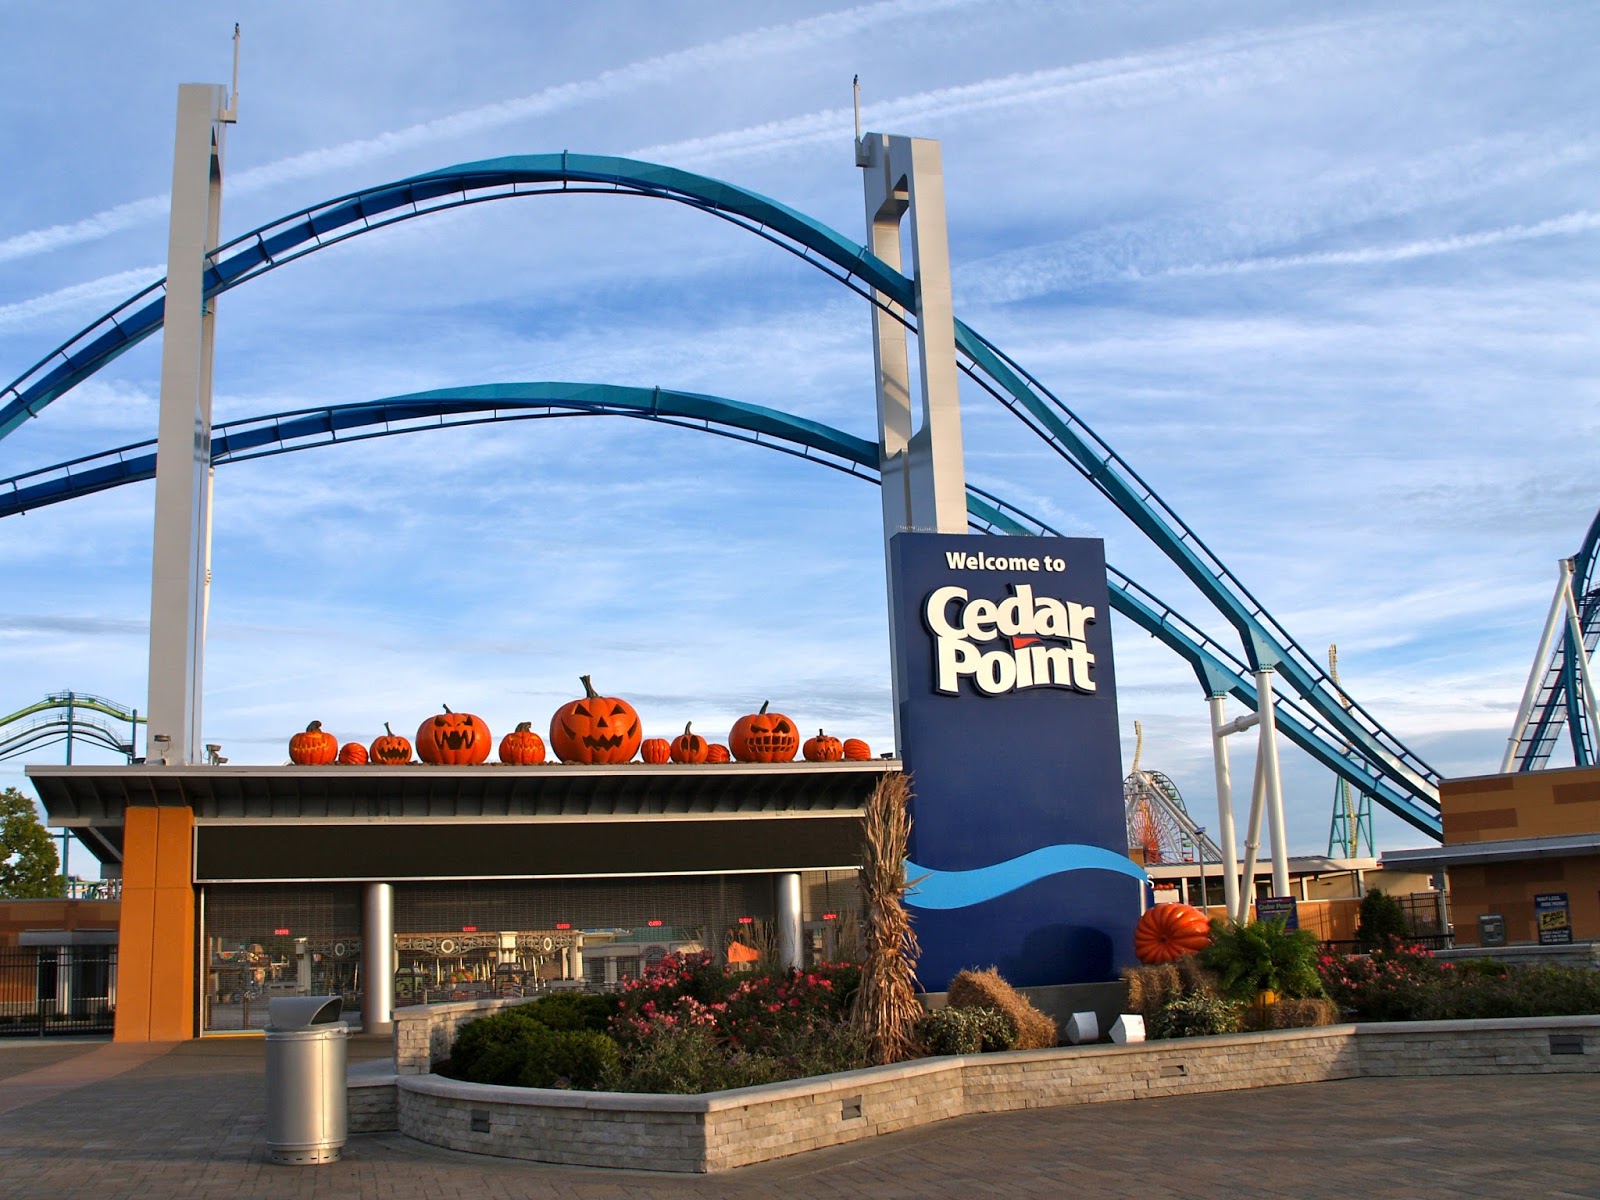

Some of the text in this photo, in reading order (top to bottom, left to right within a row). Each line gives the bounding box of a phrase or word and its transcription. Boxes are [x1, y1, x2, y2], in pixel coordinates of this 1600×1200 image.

[946, 551, 1067, 573] Welcome to
[926, 583, 1096, 642] Cedar
[937, 636, 1097, 694] Point
